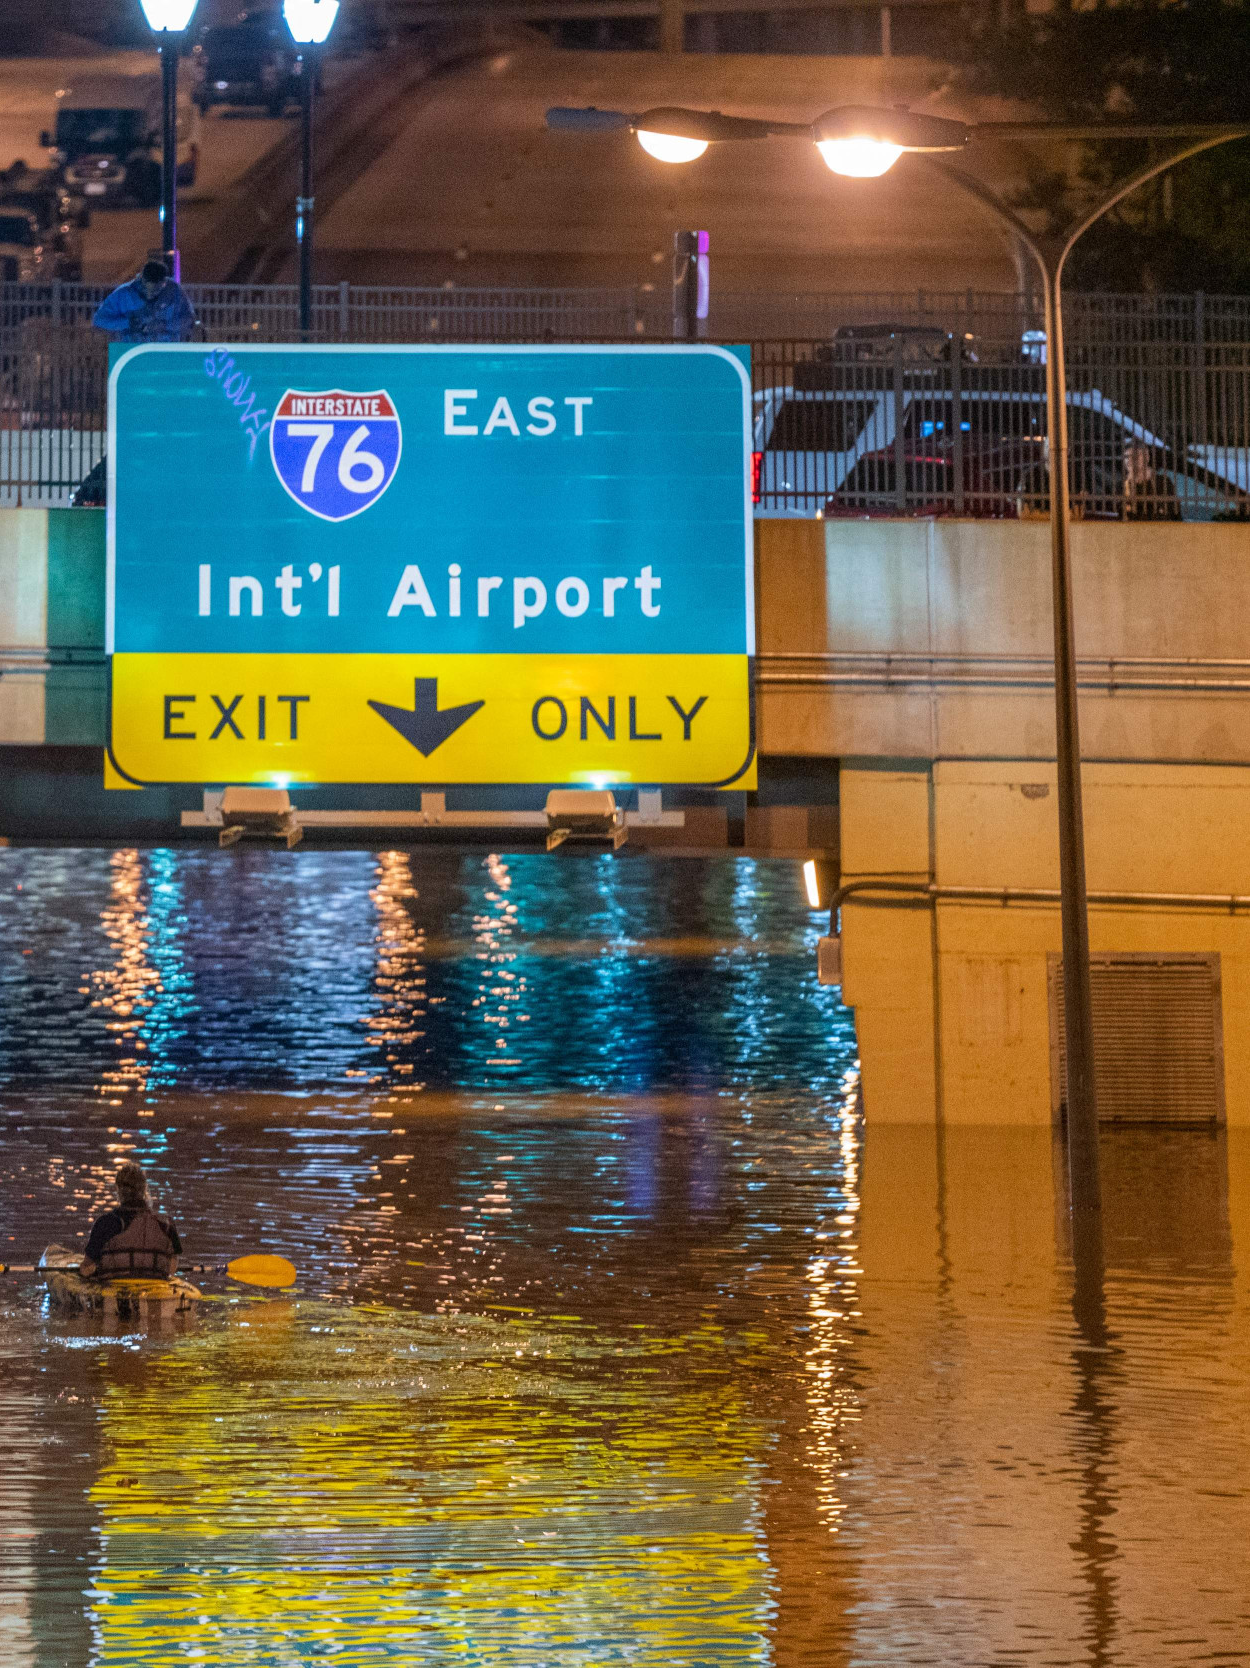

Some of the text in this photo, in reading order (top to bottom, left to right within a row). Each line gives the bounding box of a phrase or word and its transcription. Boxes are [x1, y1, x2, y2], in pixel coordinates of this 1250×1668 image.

[291, 398, 382, 417] INTERSTATE
[444, 389, 593, 437] EAST
[286, 423, 386, 493] 76
[199, 563, 661, 628] Int'l Airport
[163, 695, 708, 741] EXIT ONLY
